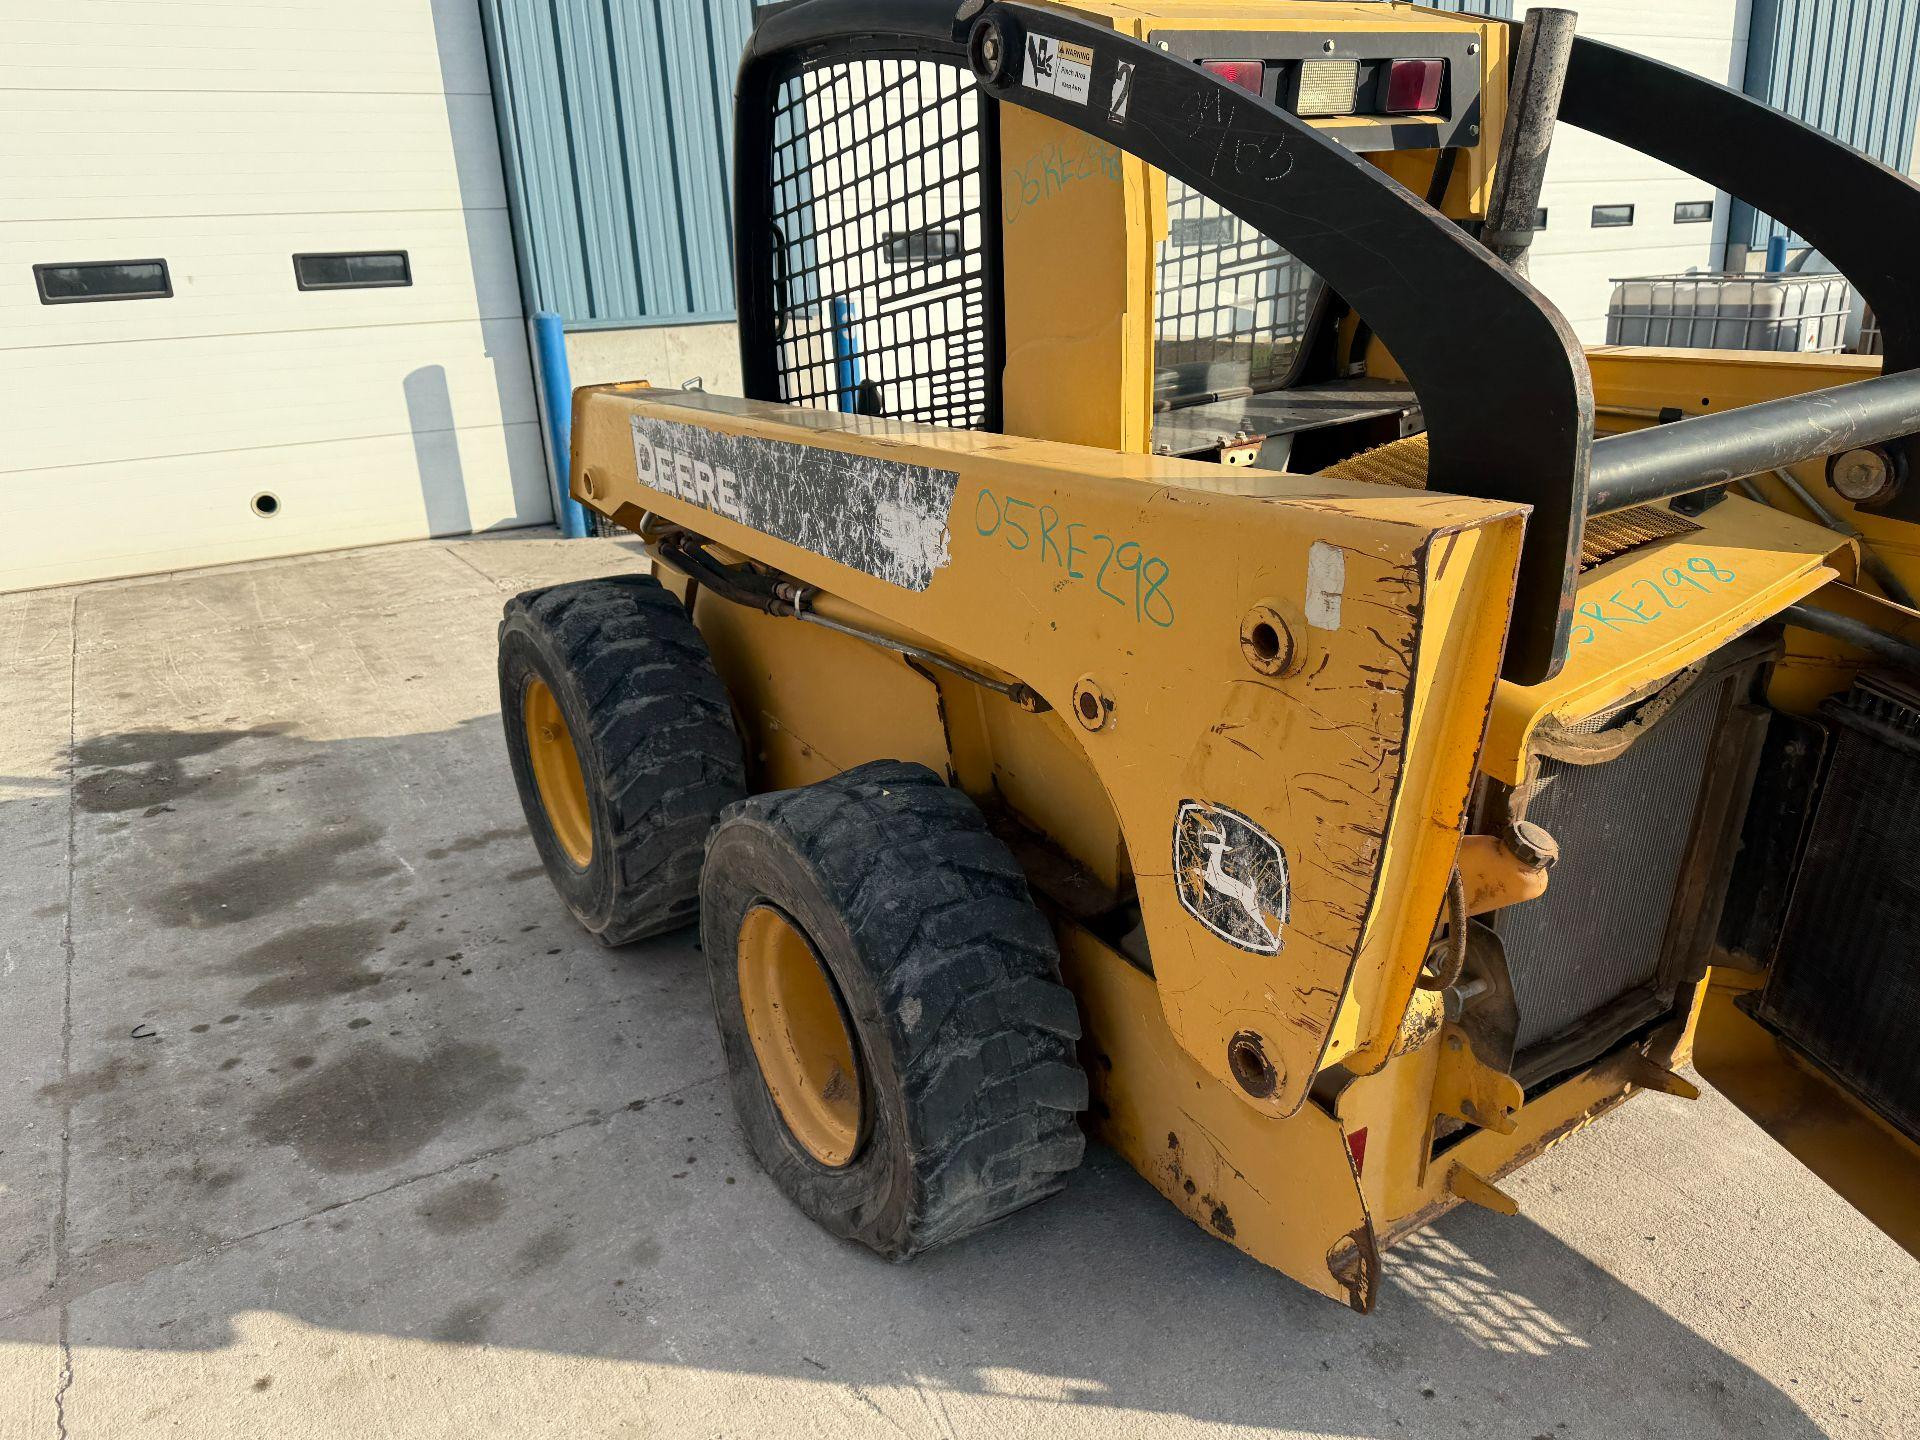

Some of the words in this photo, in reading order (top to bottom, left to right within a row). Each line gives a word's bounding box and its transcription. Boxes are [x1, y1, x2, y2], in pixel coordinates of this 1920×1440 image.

[1065, 47, 1091, 62] WARNING
[633, 430, 742, 518] DEERE
[975, 488, 1175, 628] 05RE298
[1565, 556, 1737, 661] 5RE298
